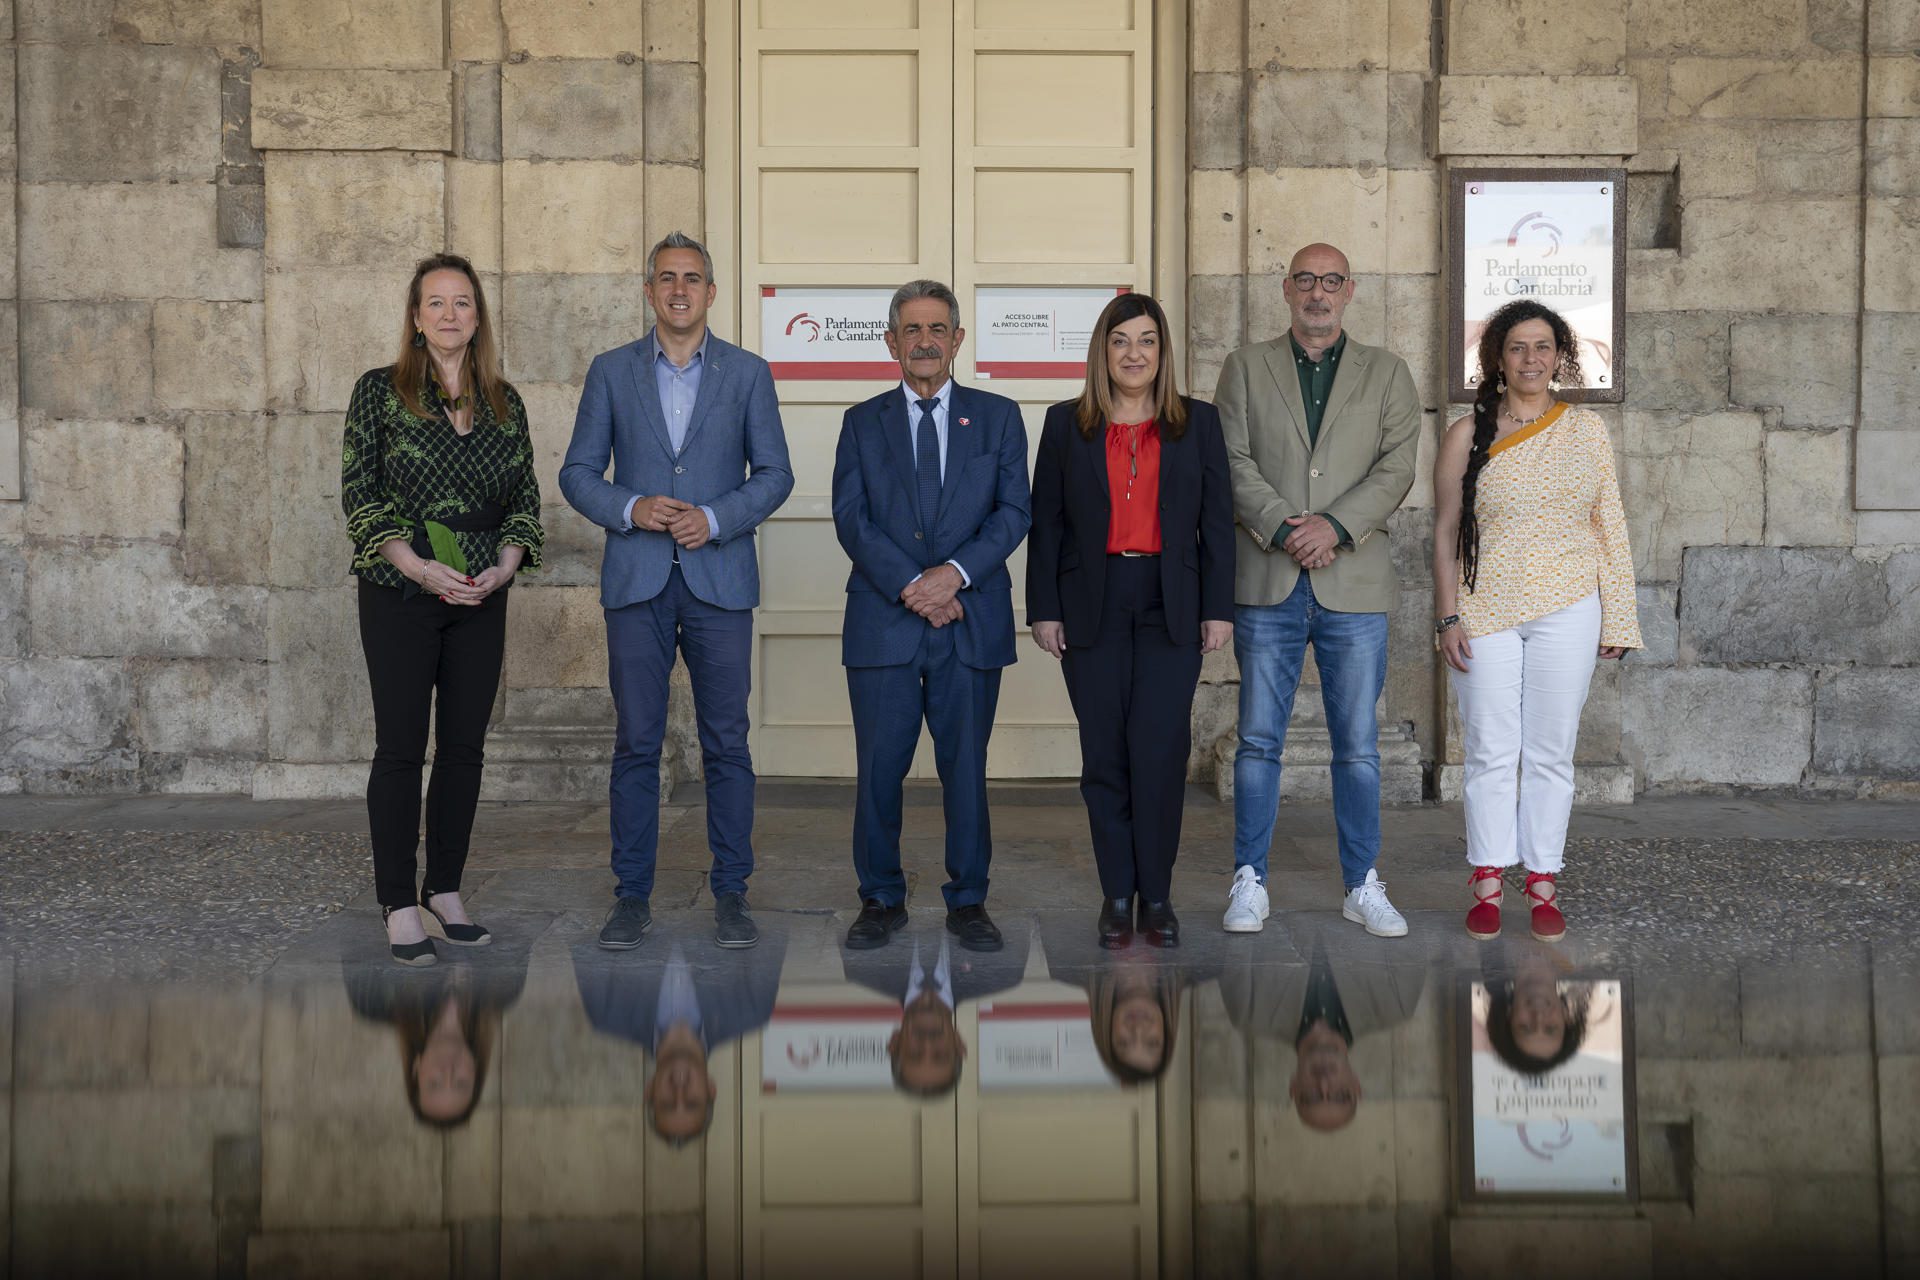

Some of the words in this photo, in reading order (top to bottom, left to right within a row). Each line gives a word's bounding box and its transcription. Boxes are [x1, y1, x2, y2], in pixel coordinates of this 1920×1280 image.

[1485, 258, 1588, 277] Parlamento
[1483, 282, 1500, 296] de
[1503, 278, 1593, 296] Cantabria
[824, 317, 889, 329] Parlamento
[823, 332, 834, 341] de
[836, 329, 884, 341] Cantabr
